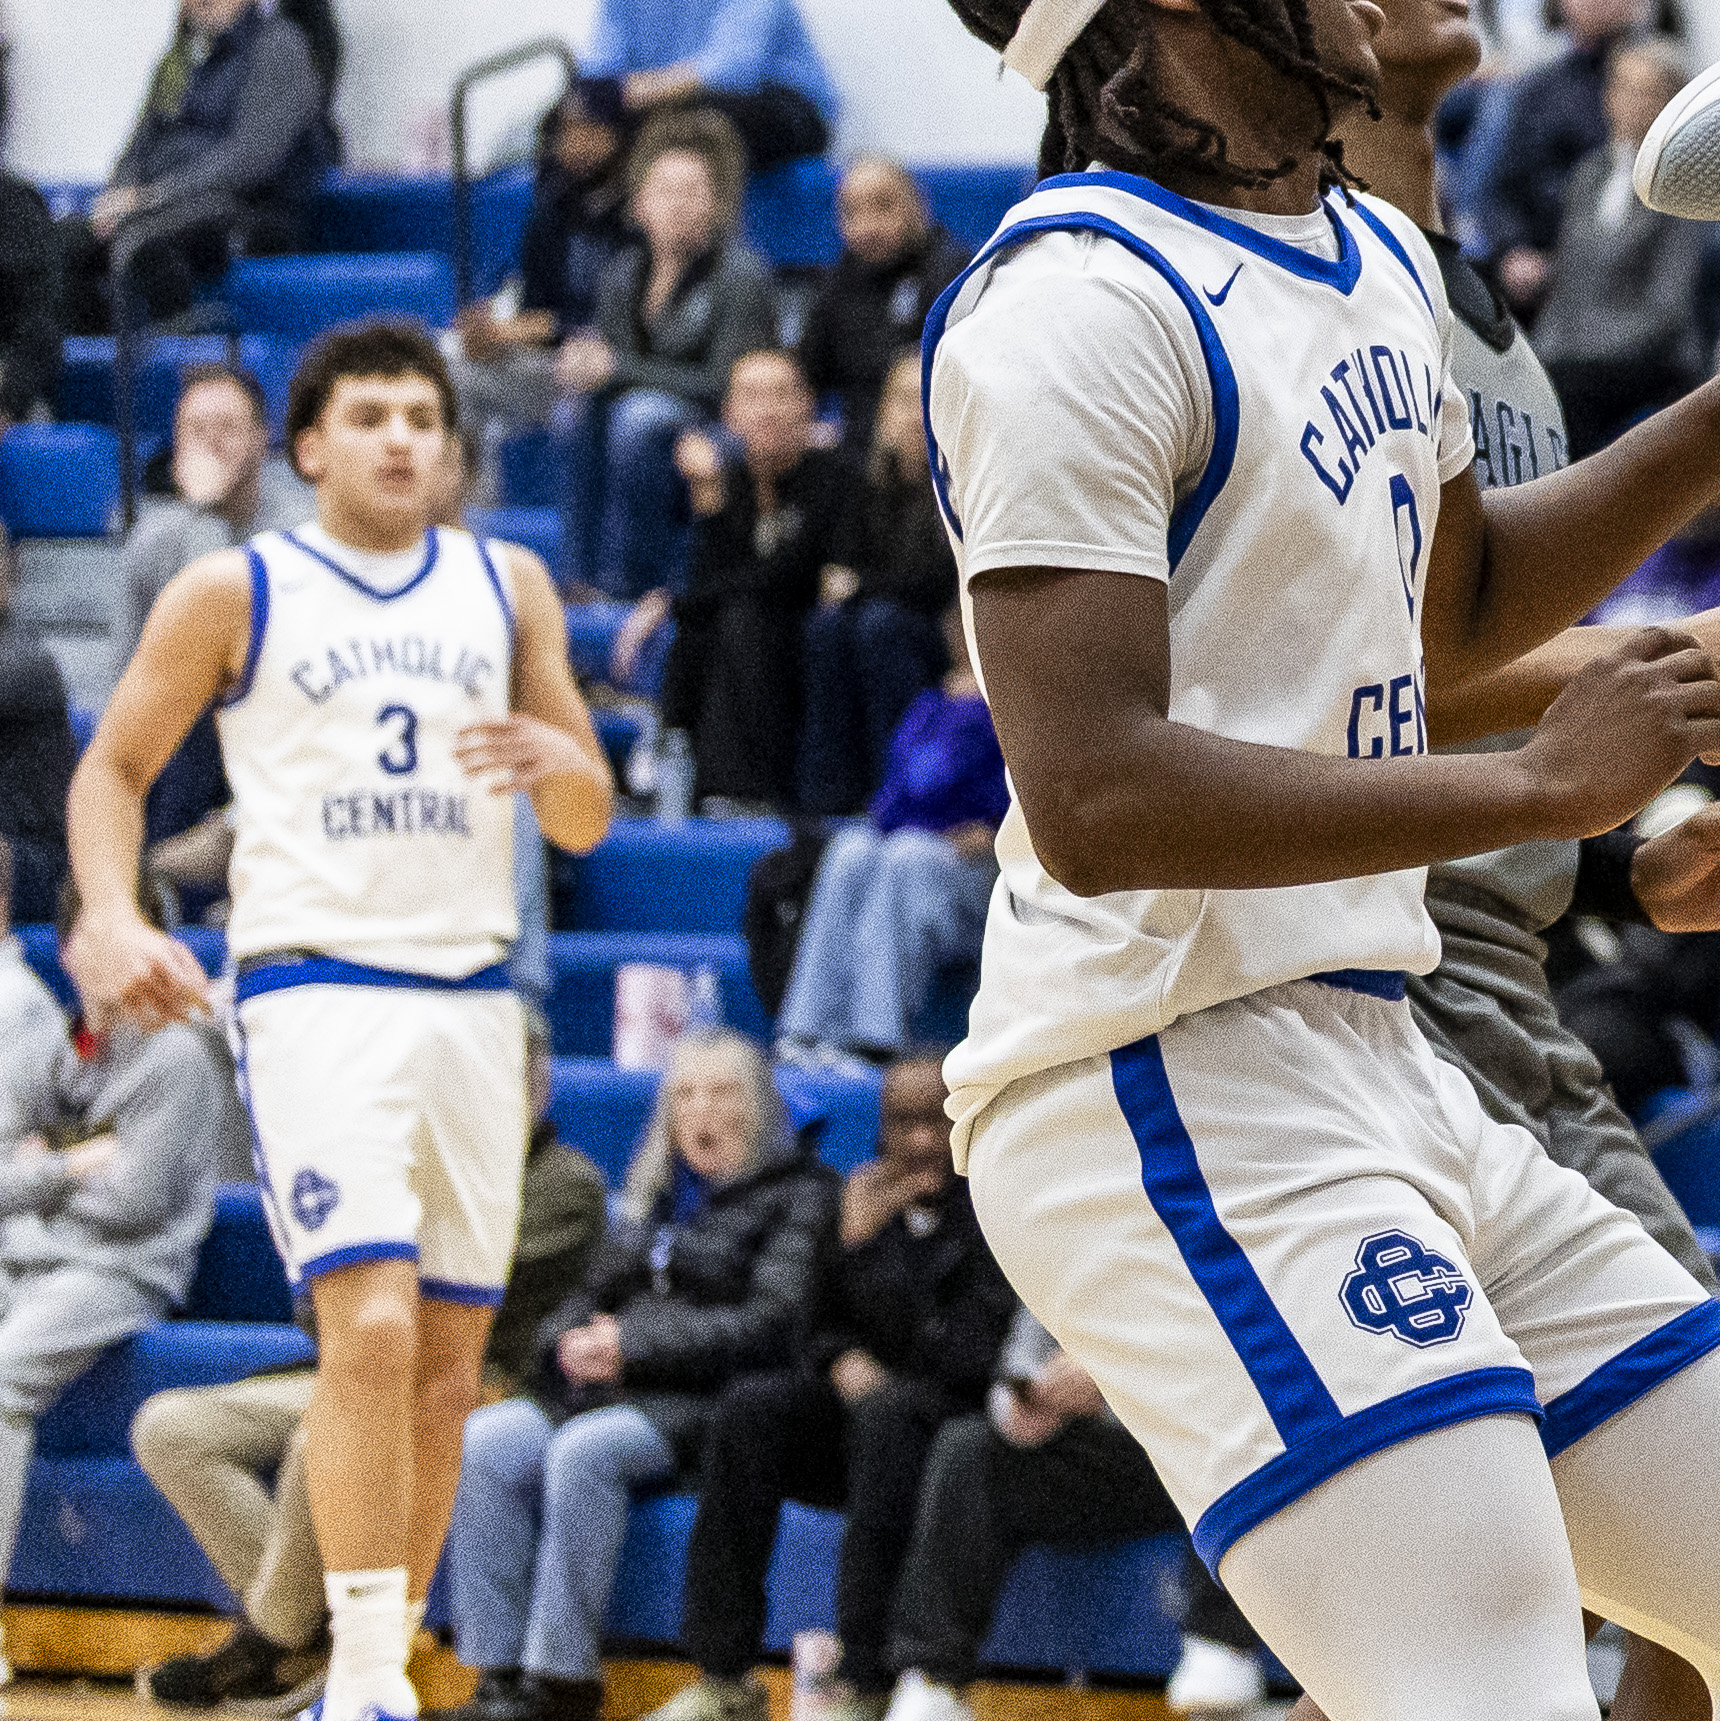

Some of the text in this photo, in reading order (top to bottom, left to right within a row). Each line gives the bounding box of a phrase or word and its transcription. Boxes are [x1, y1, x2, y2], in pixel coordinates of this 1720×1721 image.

[290, 634, 493, 705] CATHOLIC
[376, 703, 418, 776] 3
[321, 787, 472, 841] CENTRAL
